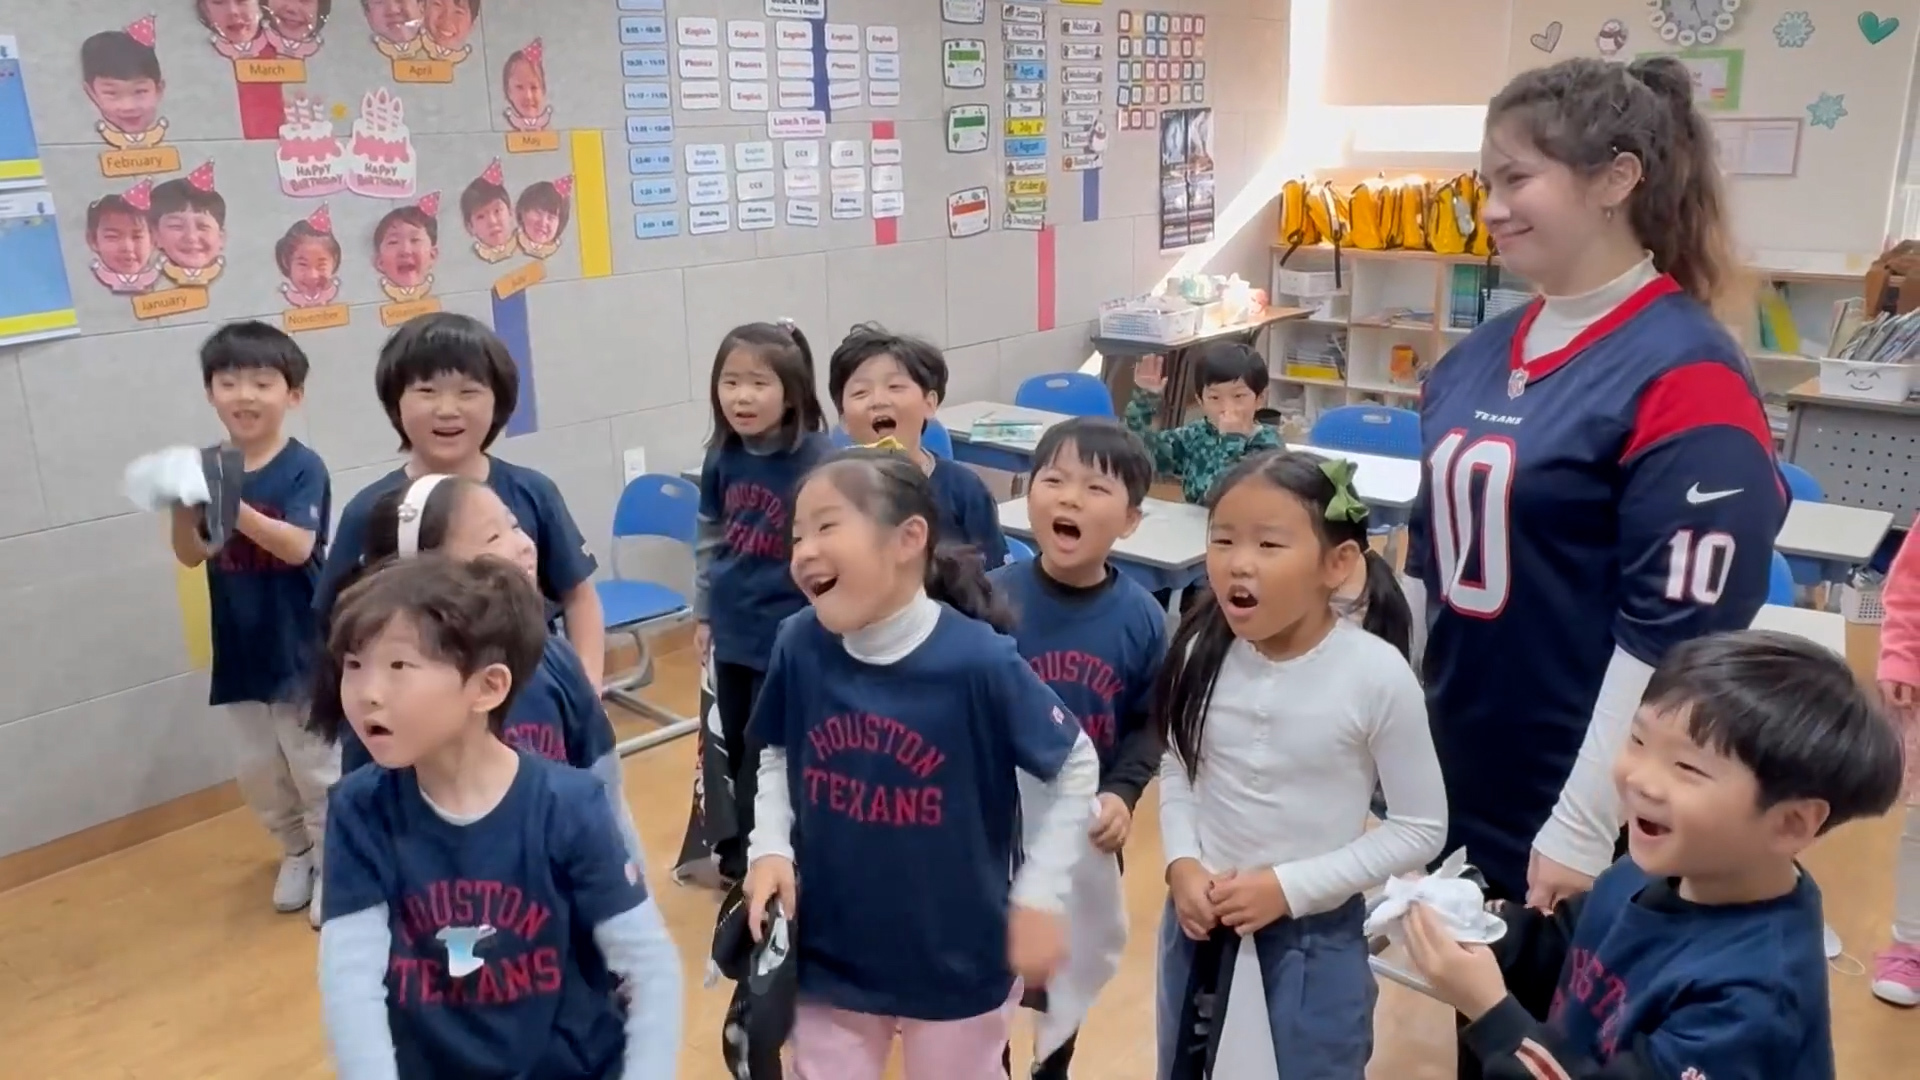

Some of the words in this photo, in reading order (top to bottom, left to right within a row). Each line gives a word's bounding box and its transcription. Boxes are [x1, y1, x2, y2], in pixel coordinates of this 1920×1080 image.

[684, 27, 711, 37] English
[734, 30, 759, 39] English
[783, 31, 806, 40] English
[831, 33, 853, 42] English
[872, 35, 893, 43] English
[249, 63, 285, 76] March
[684, 59, 712, 67] Phonics
[735, 61, 762, 69] Phonics
[831, 62, 856, 70] Phonics
[409, 65, 433, 78] April
[737, 92, 763, 101] English
[773, 117, 799, 126] Lunch
[801, 116, 821, 126] Time
[522, 136, 542, 147] May
[106, 155, 163, 170] February
[296, 164, 331, 176] HAPPY
[364, 163, 397, 176] HAPPY
[289, 174, 343, 192] BIRTHDAY
[356, 173, 407, 188] BIRTHDAY
[141, 296, 188, 310] January
[288, 311, 338, 324] November
[1474, 409, 1523, 425] TEXANS
[1429, 427, 1516, 619] 10
[1665, 529, 1736, 605] 10
[1030, 650, 1125, 704] OUSTON
[806, 711, 945, 778] HOUSTON
[802, 765, 944, 826] TEXANS
